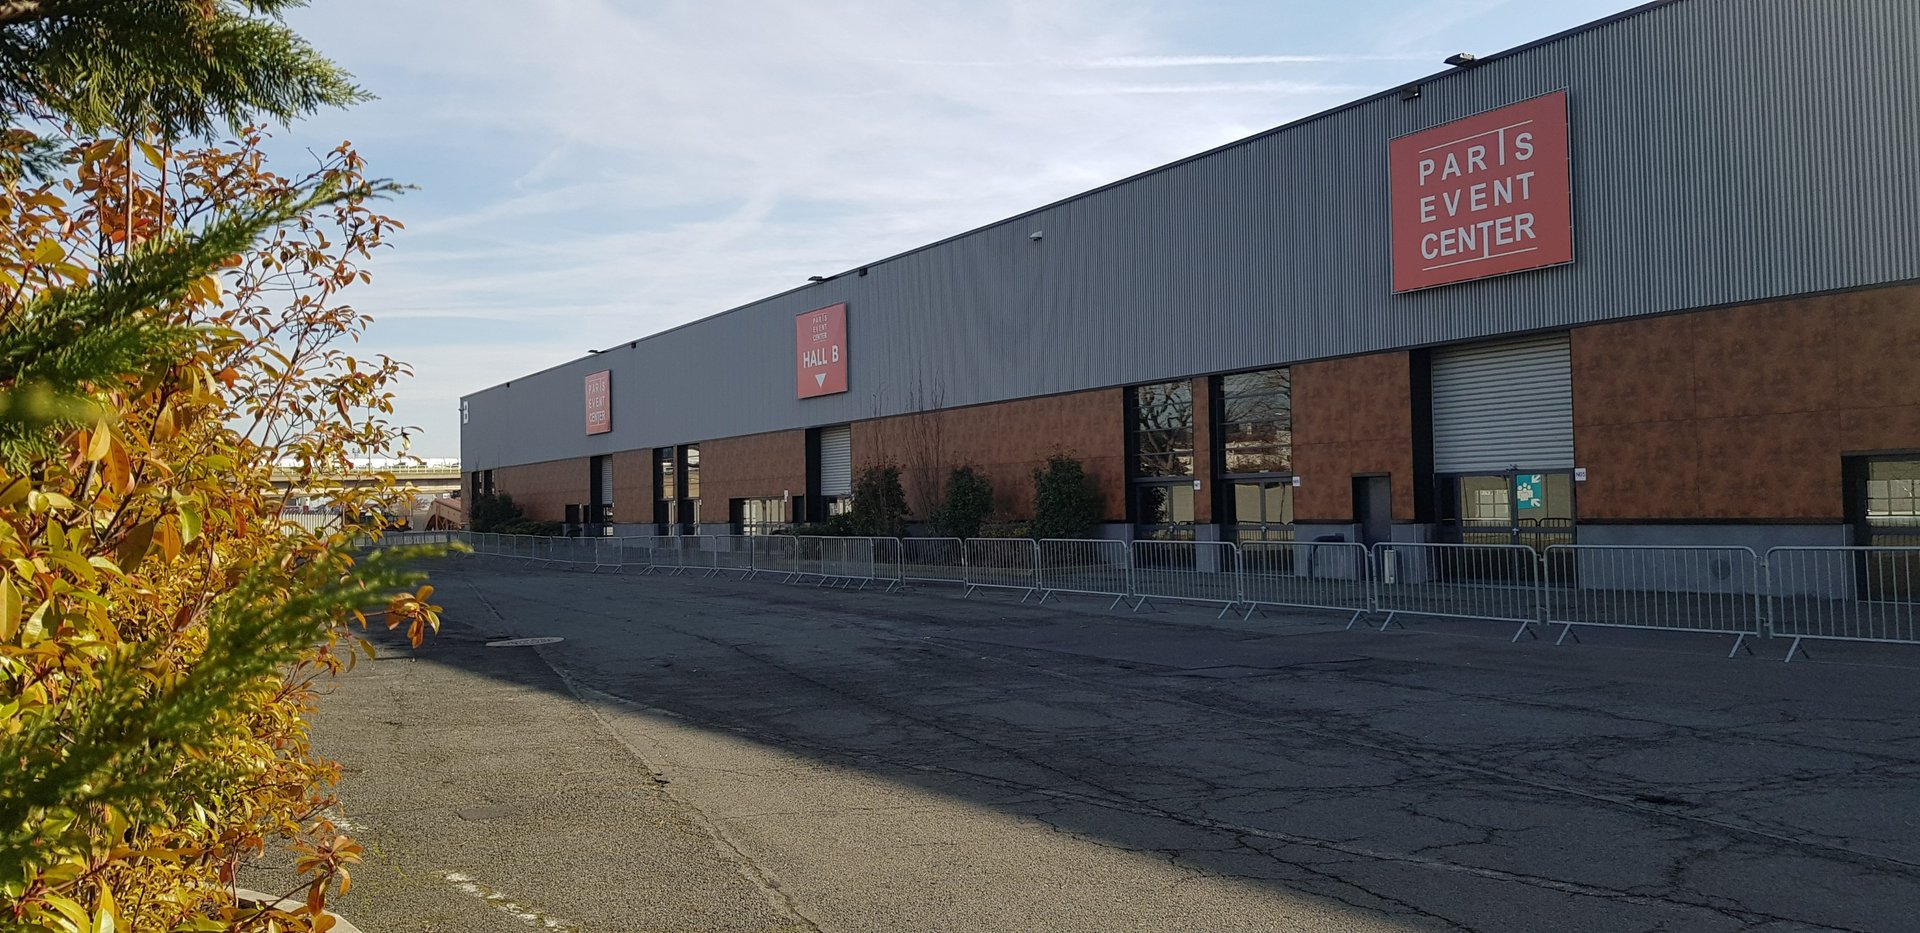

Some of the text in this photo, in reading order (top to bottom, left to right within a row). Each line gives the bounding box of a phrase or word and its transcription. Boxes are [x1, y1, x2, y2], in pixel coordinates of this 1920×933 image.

[1419, 128, 1534, 186] PARIS
[1420, 171, 1535, 223] EVENT
[1421, 212, 1536, 260] CENTER
[812, 314, 827, 324] PARIS
[812, 324, 827, 333] EVENT
[812, 332, 827, 342] CENTER
[803, 345, 839, 368] HALL B
[588, 379, 605, 395] PARIS
[588, 396, 605, 409] EVENT
[589, 410, 606, 424] CENTER
